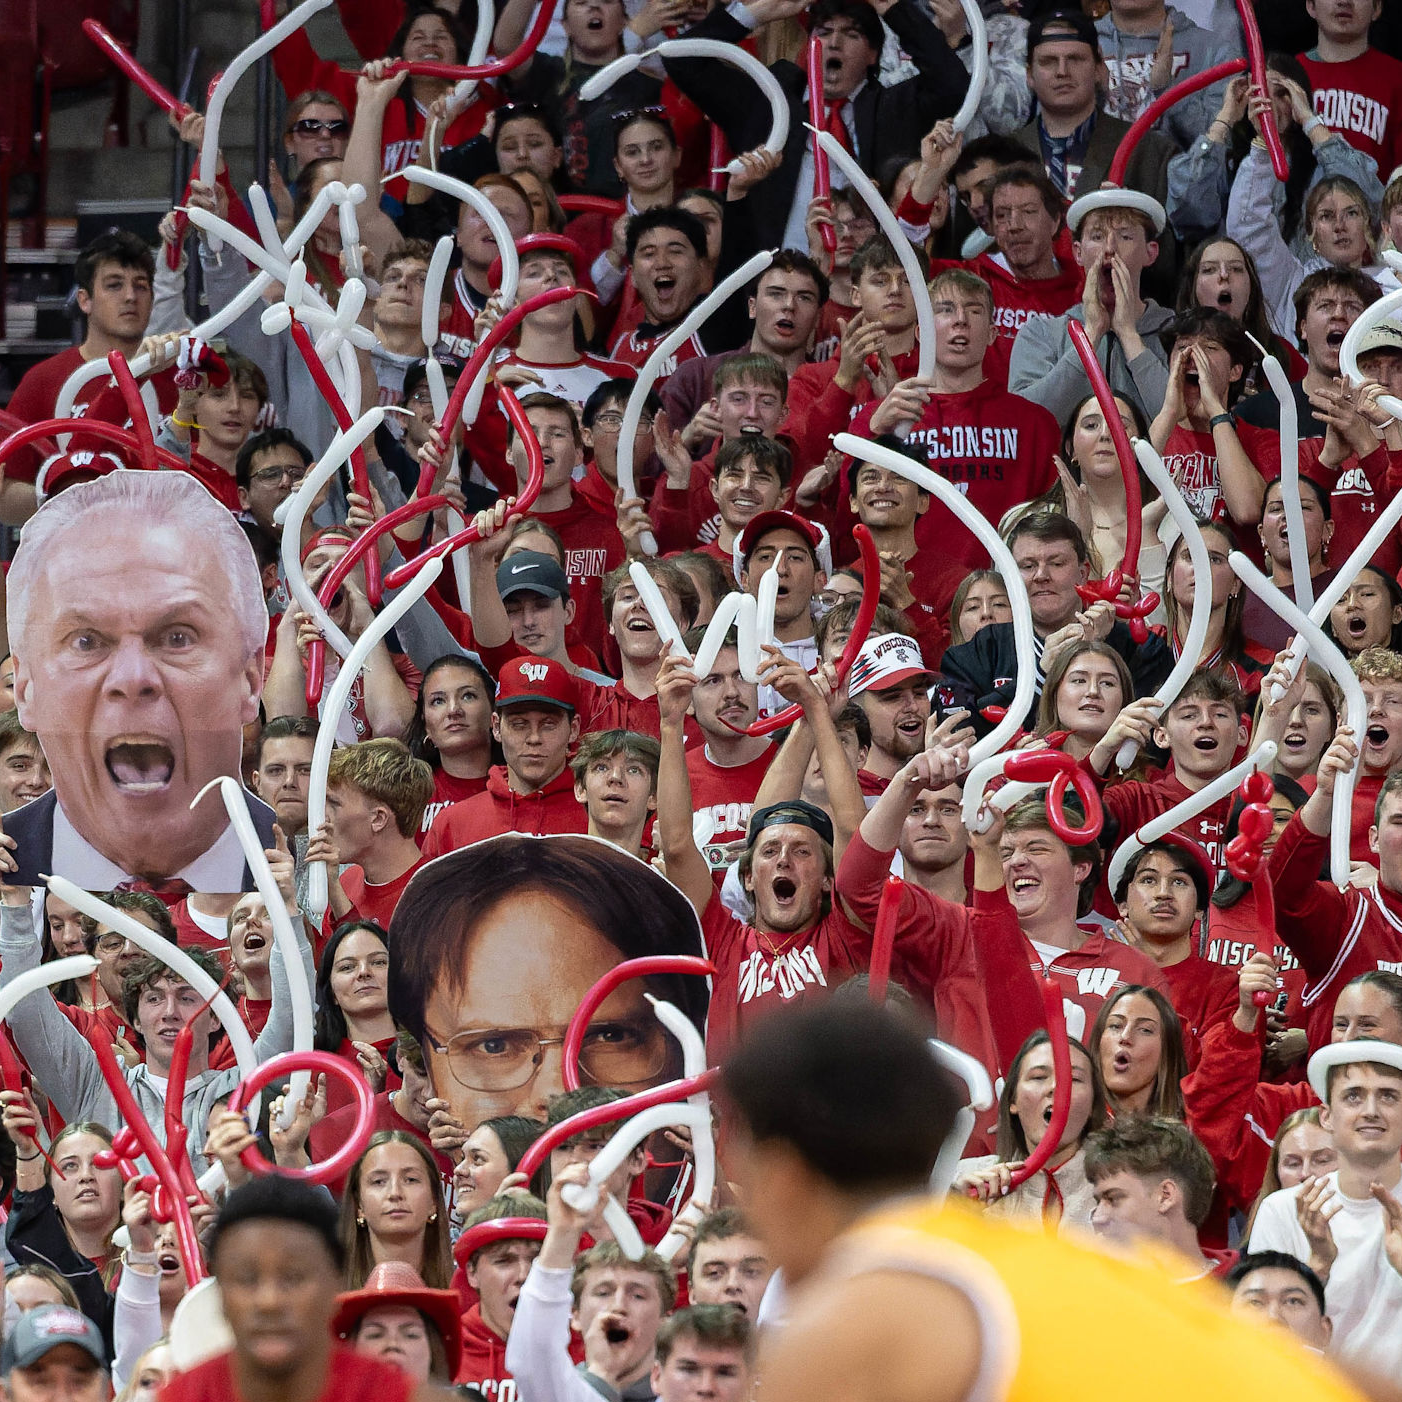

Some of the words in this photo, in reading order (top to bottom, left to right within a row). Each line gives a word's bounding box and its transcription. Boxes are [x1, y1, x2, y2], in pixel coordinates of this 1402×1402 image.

[1309, 87, 1387, 143] CONSIN
[71, 453, 94, 468] W
[872, 636, 918, 660] WISCONSIN
[526, 664, 549, 682] W
[1076, 967, 1120, 997] W
